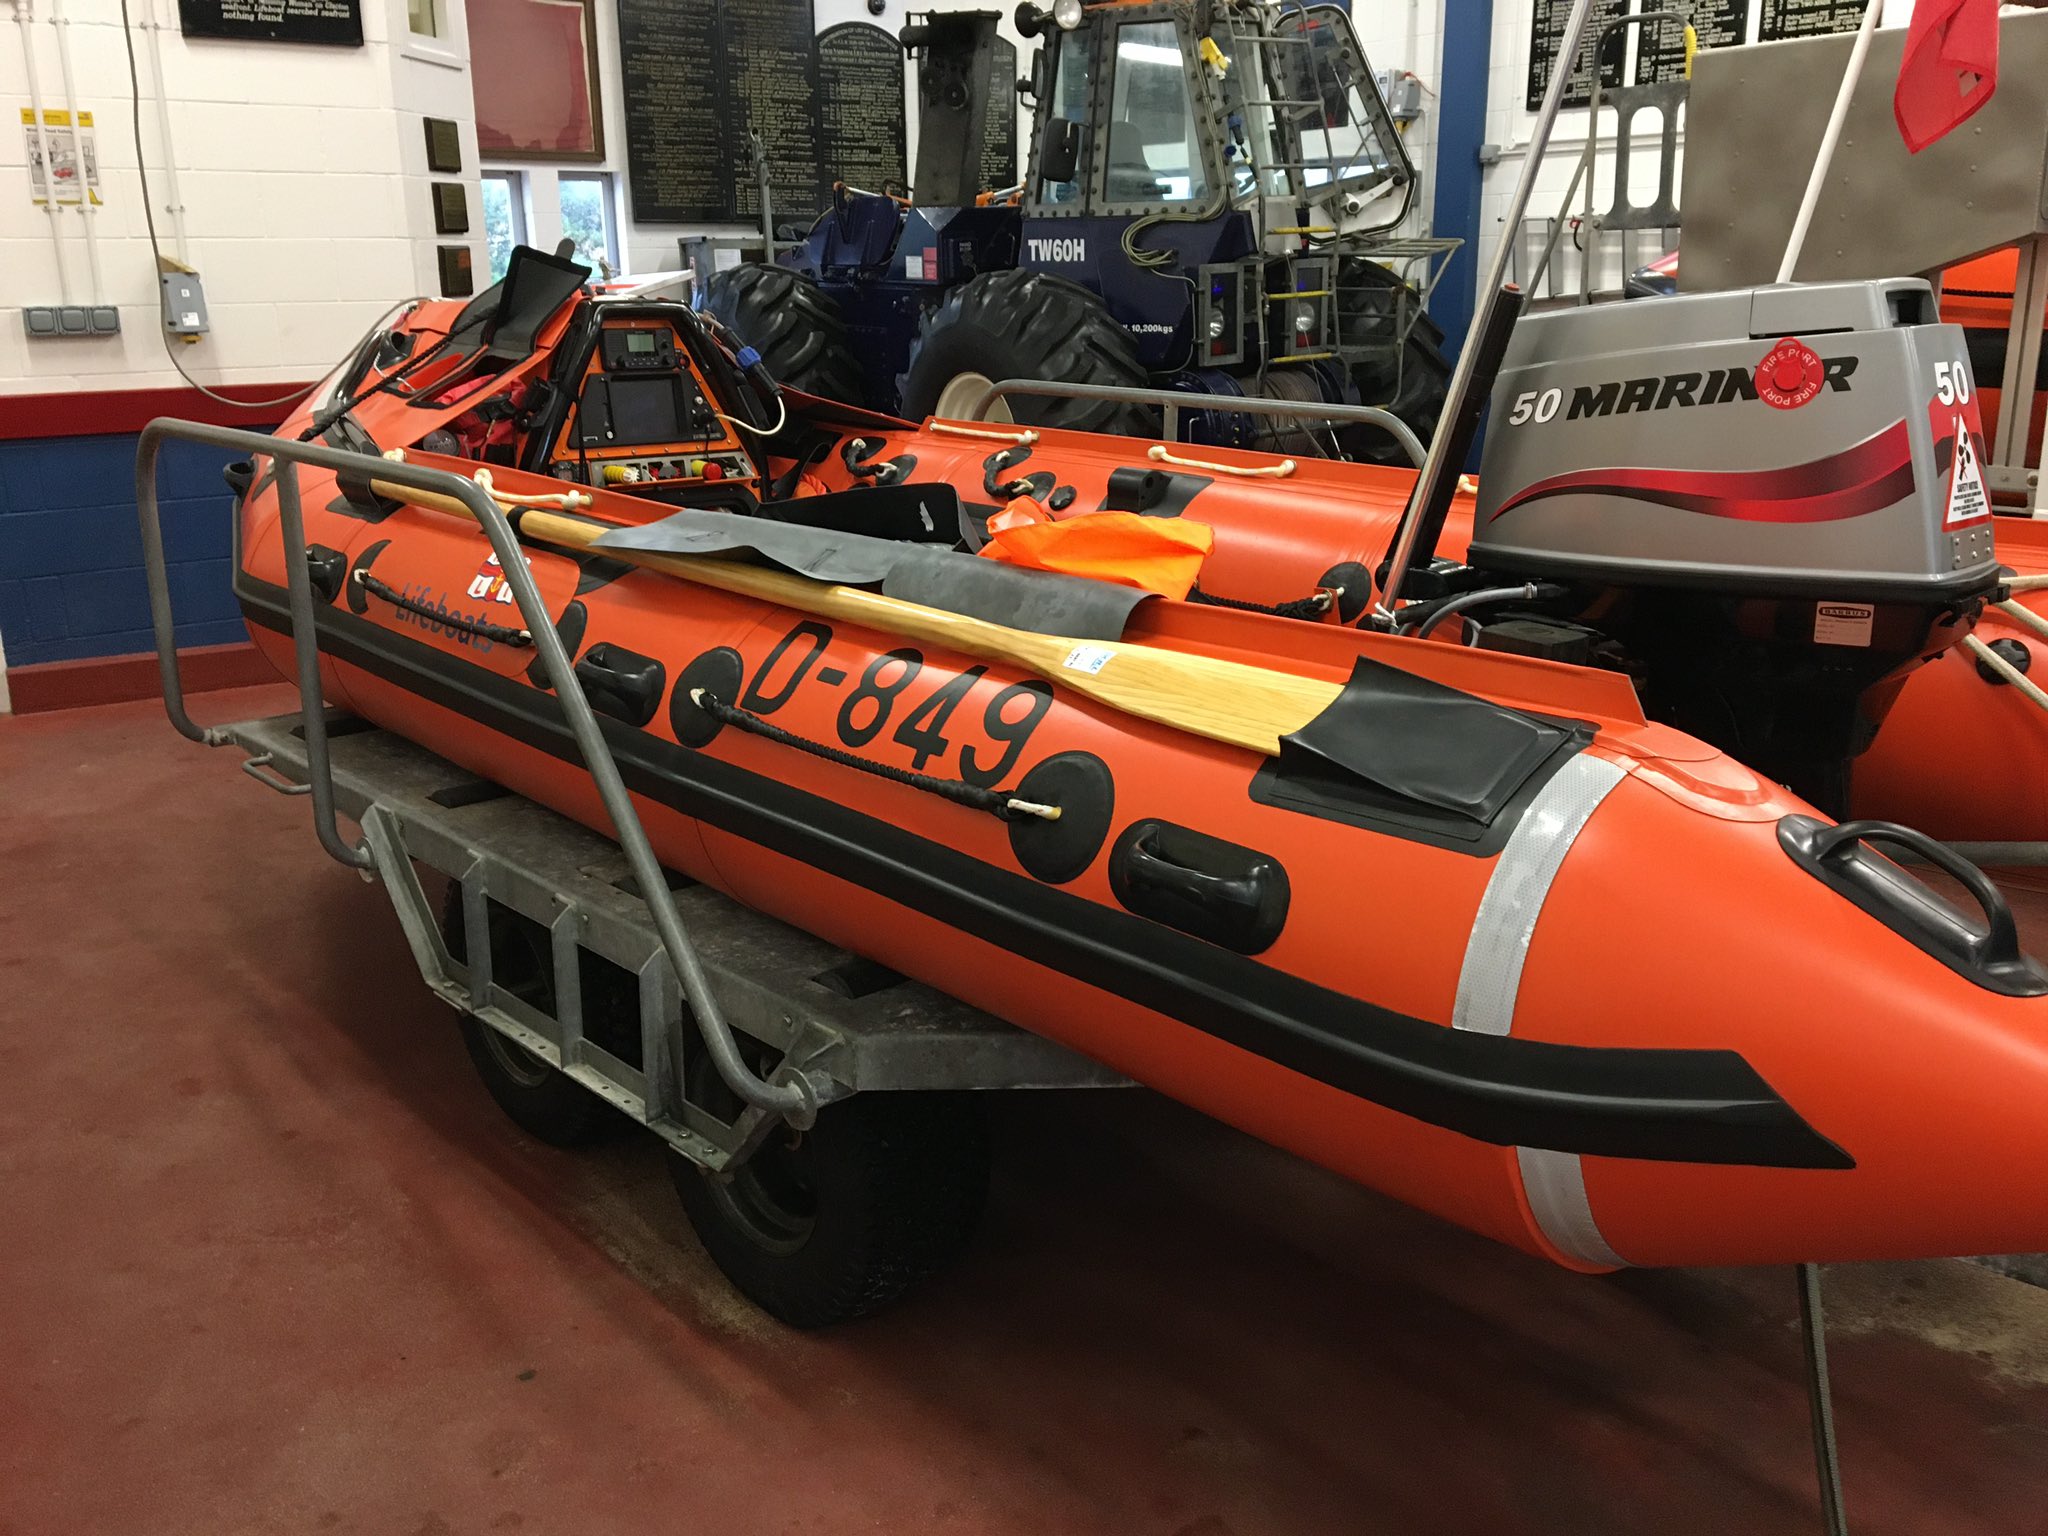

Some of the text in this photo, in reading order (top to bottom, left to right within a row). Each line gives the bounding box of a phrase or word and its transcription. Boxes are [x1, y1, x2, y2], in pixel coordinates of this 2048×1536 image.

[222, 11, 284, 22] nothing found.
[1028, 239, 1085, 262] TW60H
[1131, 323, 1174, 335] 10,200kgs
[1762, 350, 1786, 373] FIRE
[1508, 355, 1860, 426] 50 MARINR
[1762, 382, 1817, 406] PORT FIRE
[1934, 360, 1970, 407] 50
[740, 619, 1055, 789] D-849
